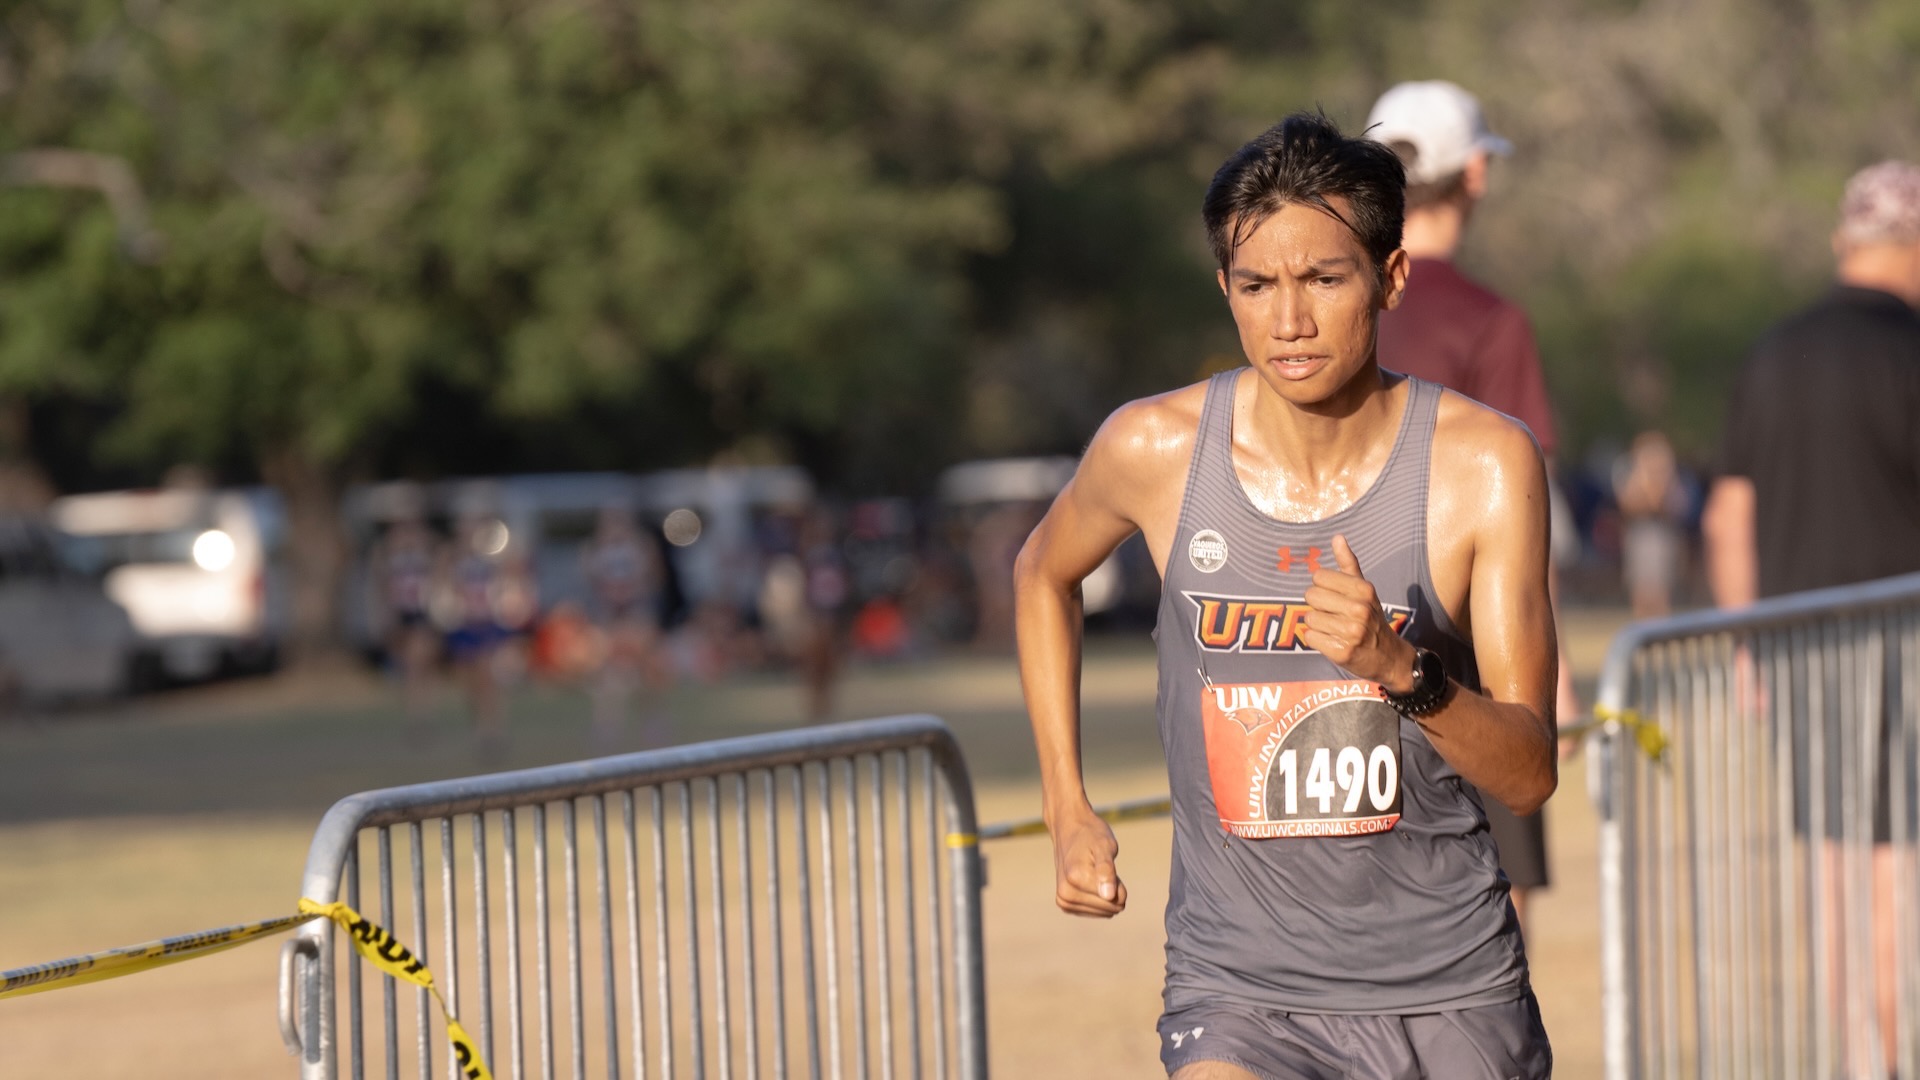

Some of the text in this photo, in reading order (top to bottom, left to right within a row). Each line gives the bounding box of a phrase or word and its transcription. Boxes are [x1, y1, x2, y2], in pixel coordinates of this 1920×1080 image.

[1192, 547, 1223, 560] UNITED
[1200, 599, 1408, 647] UTR
[1215, 685, 1282, 713] UIW
[1249, 683, 1373, 819] UIW INVITATIONAL
[1279, 744, 1398, 815] 1490
[1229, 818, 1388, 838] WWW.UIWCARDINALS.COM
